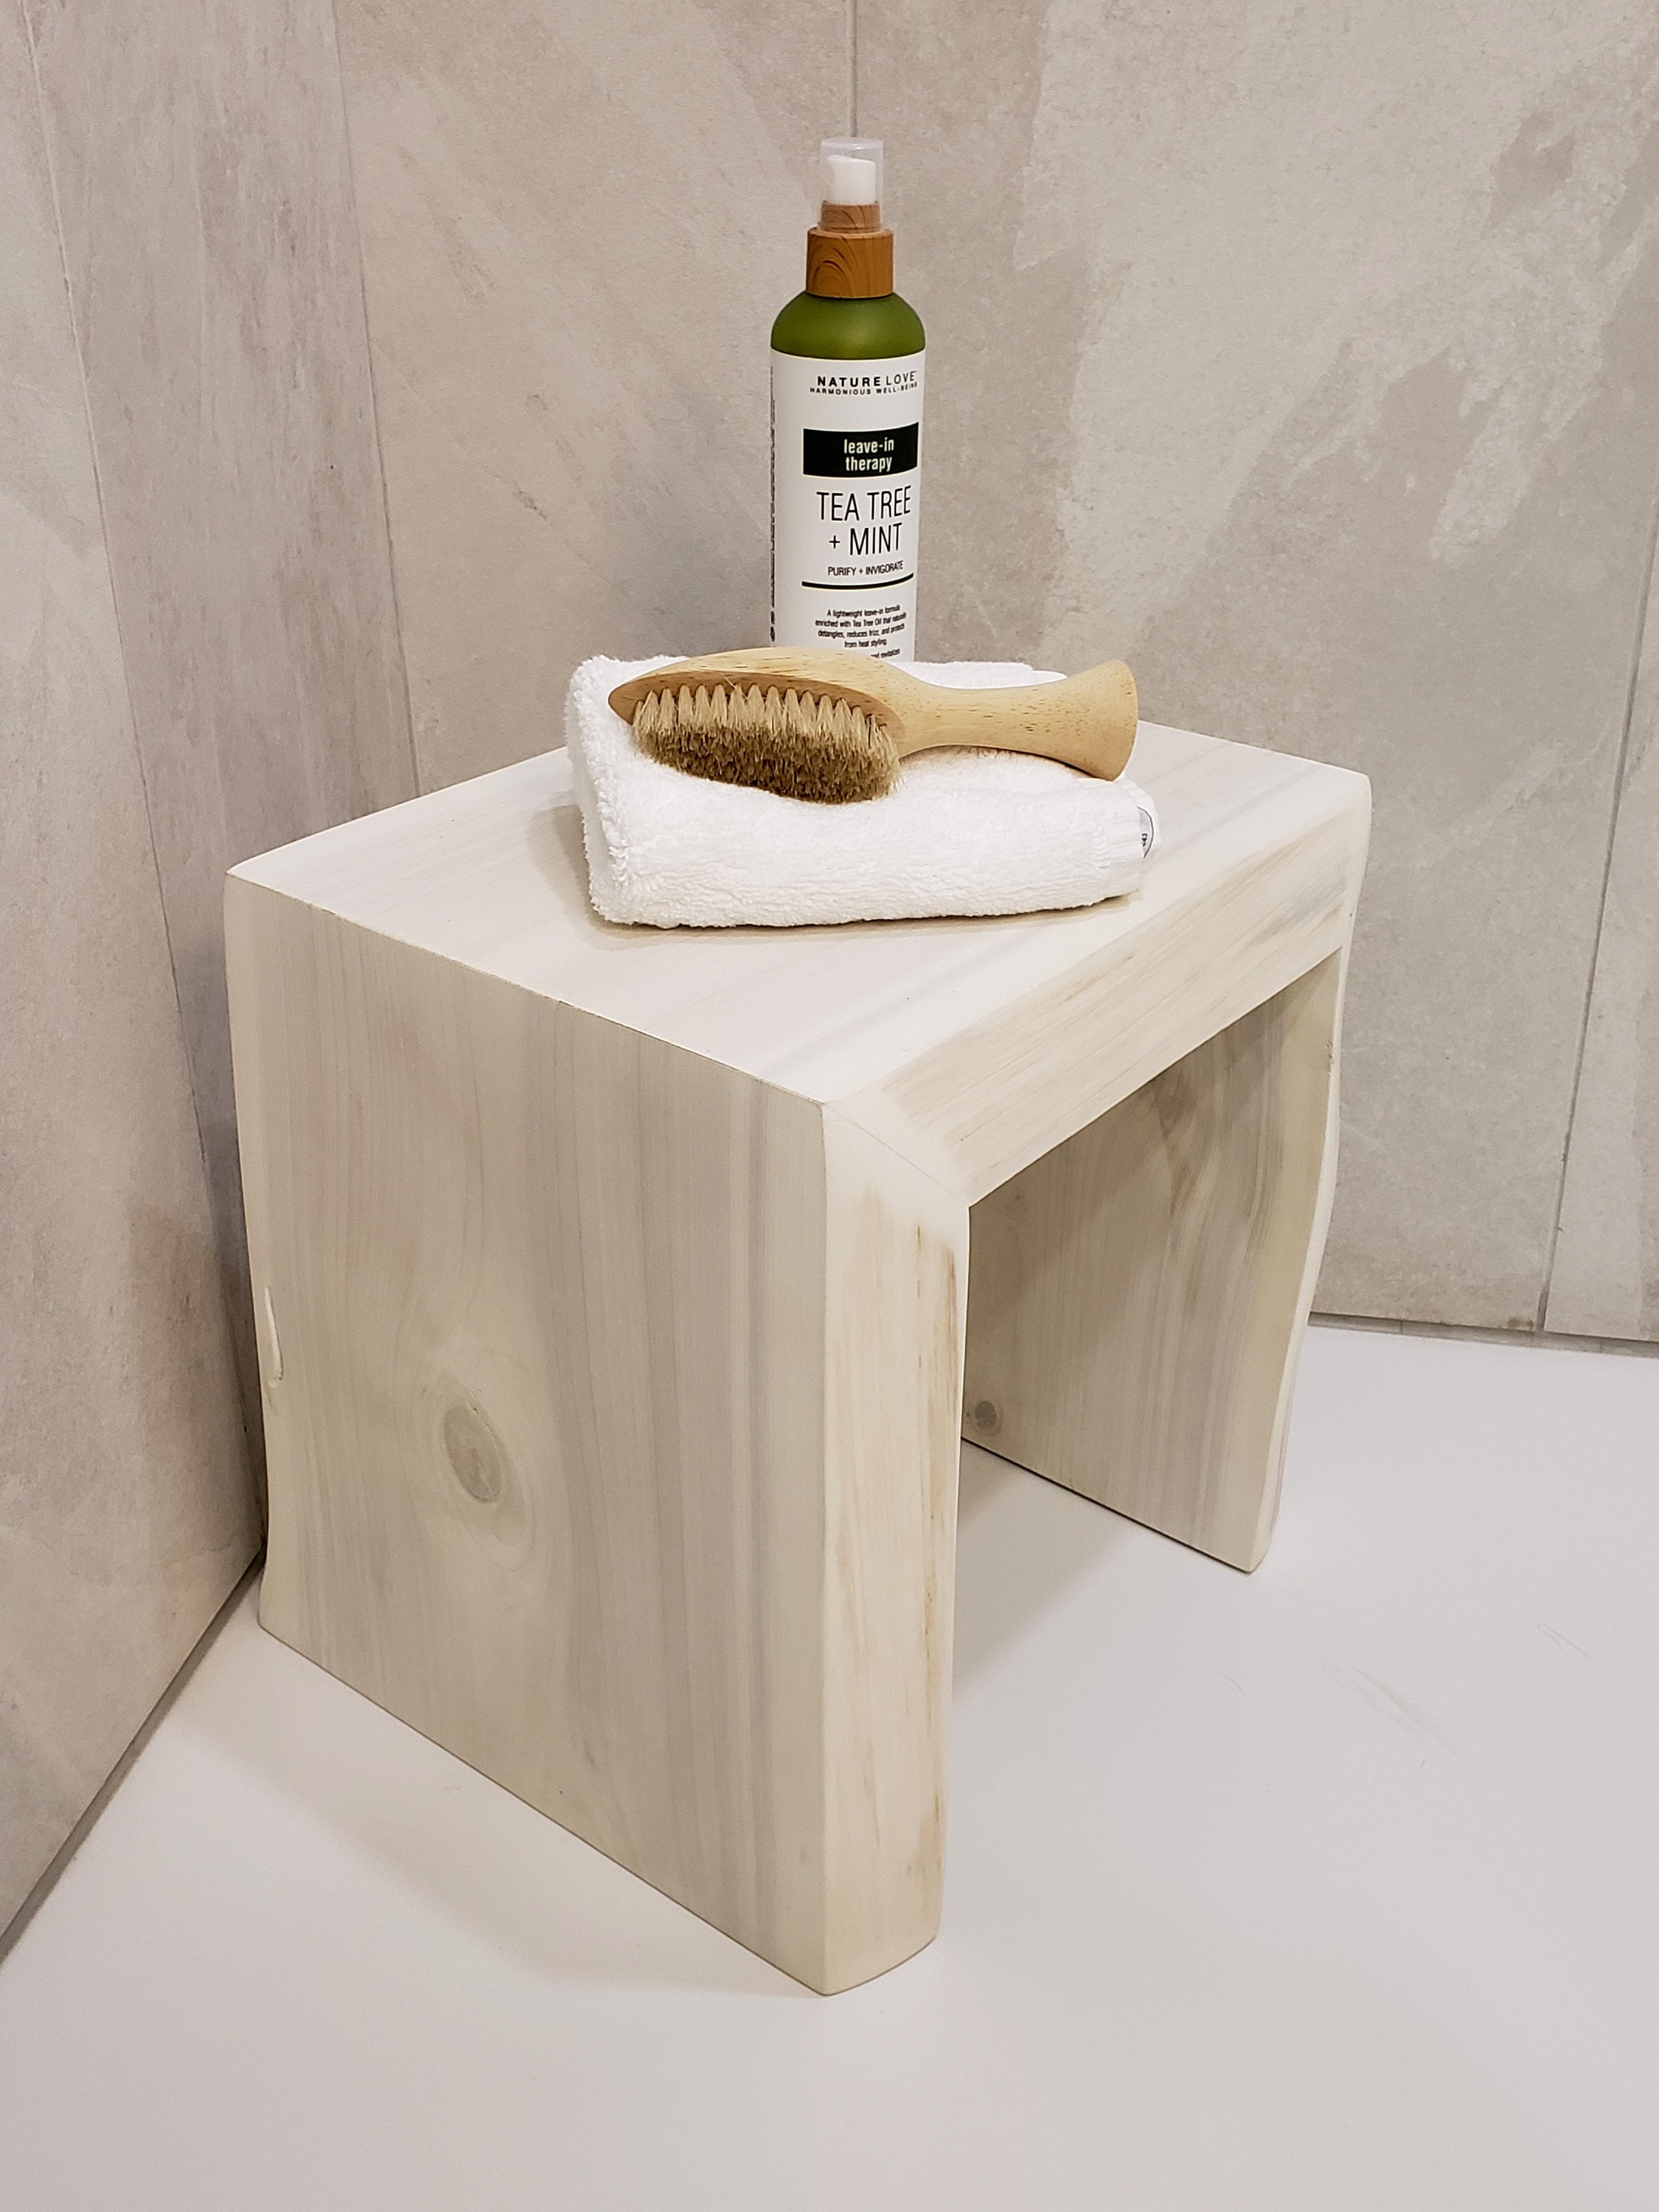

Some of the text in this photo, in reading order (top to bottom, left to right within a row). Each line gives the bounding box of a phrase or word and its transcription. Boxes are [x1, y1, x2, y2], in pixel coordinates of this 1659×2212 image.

[818, 376, 881, 387] NATURE
[810, 387, 872, 395] HARMONIOUS
[844, 437, 894, 454] leave-in
[845, 456, 893, 473] therapy
[816, 485, 911, 521] TEA TREE
[829, 522, 902, 555] + MINT
[827, 566, 856, 576] PURIFY
[866, 560, 904, 575] INVIGORATE
